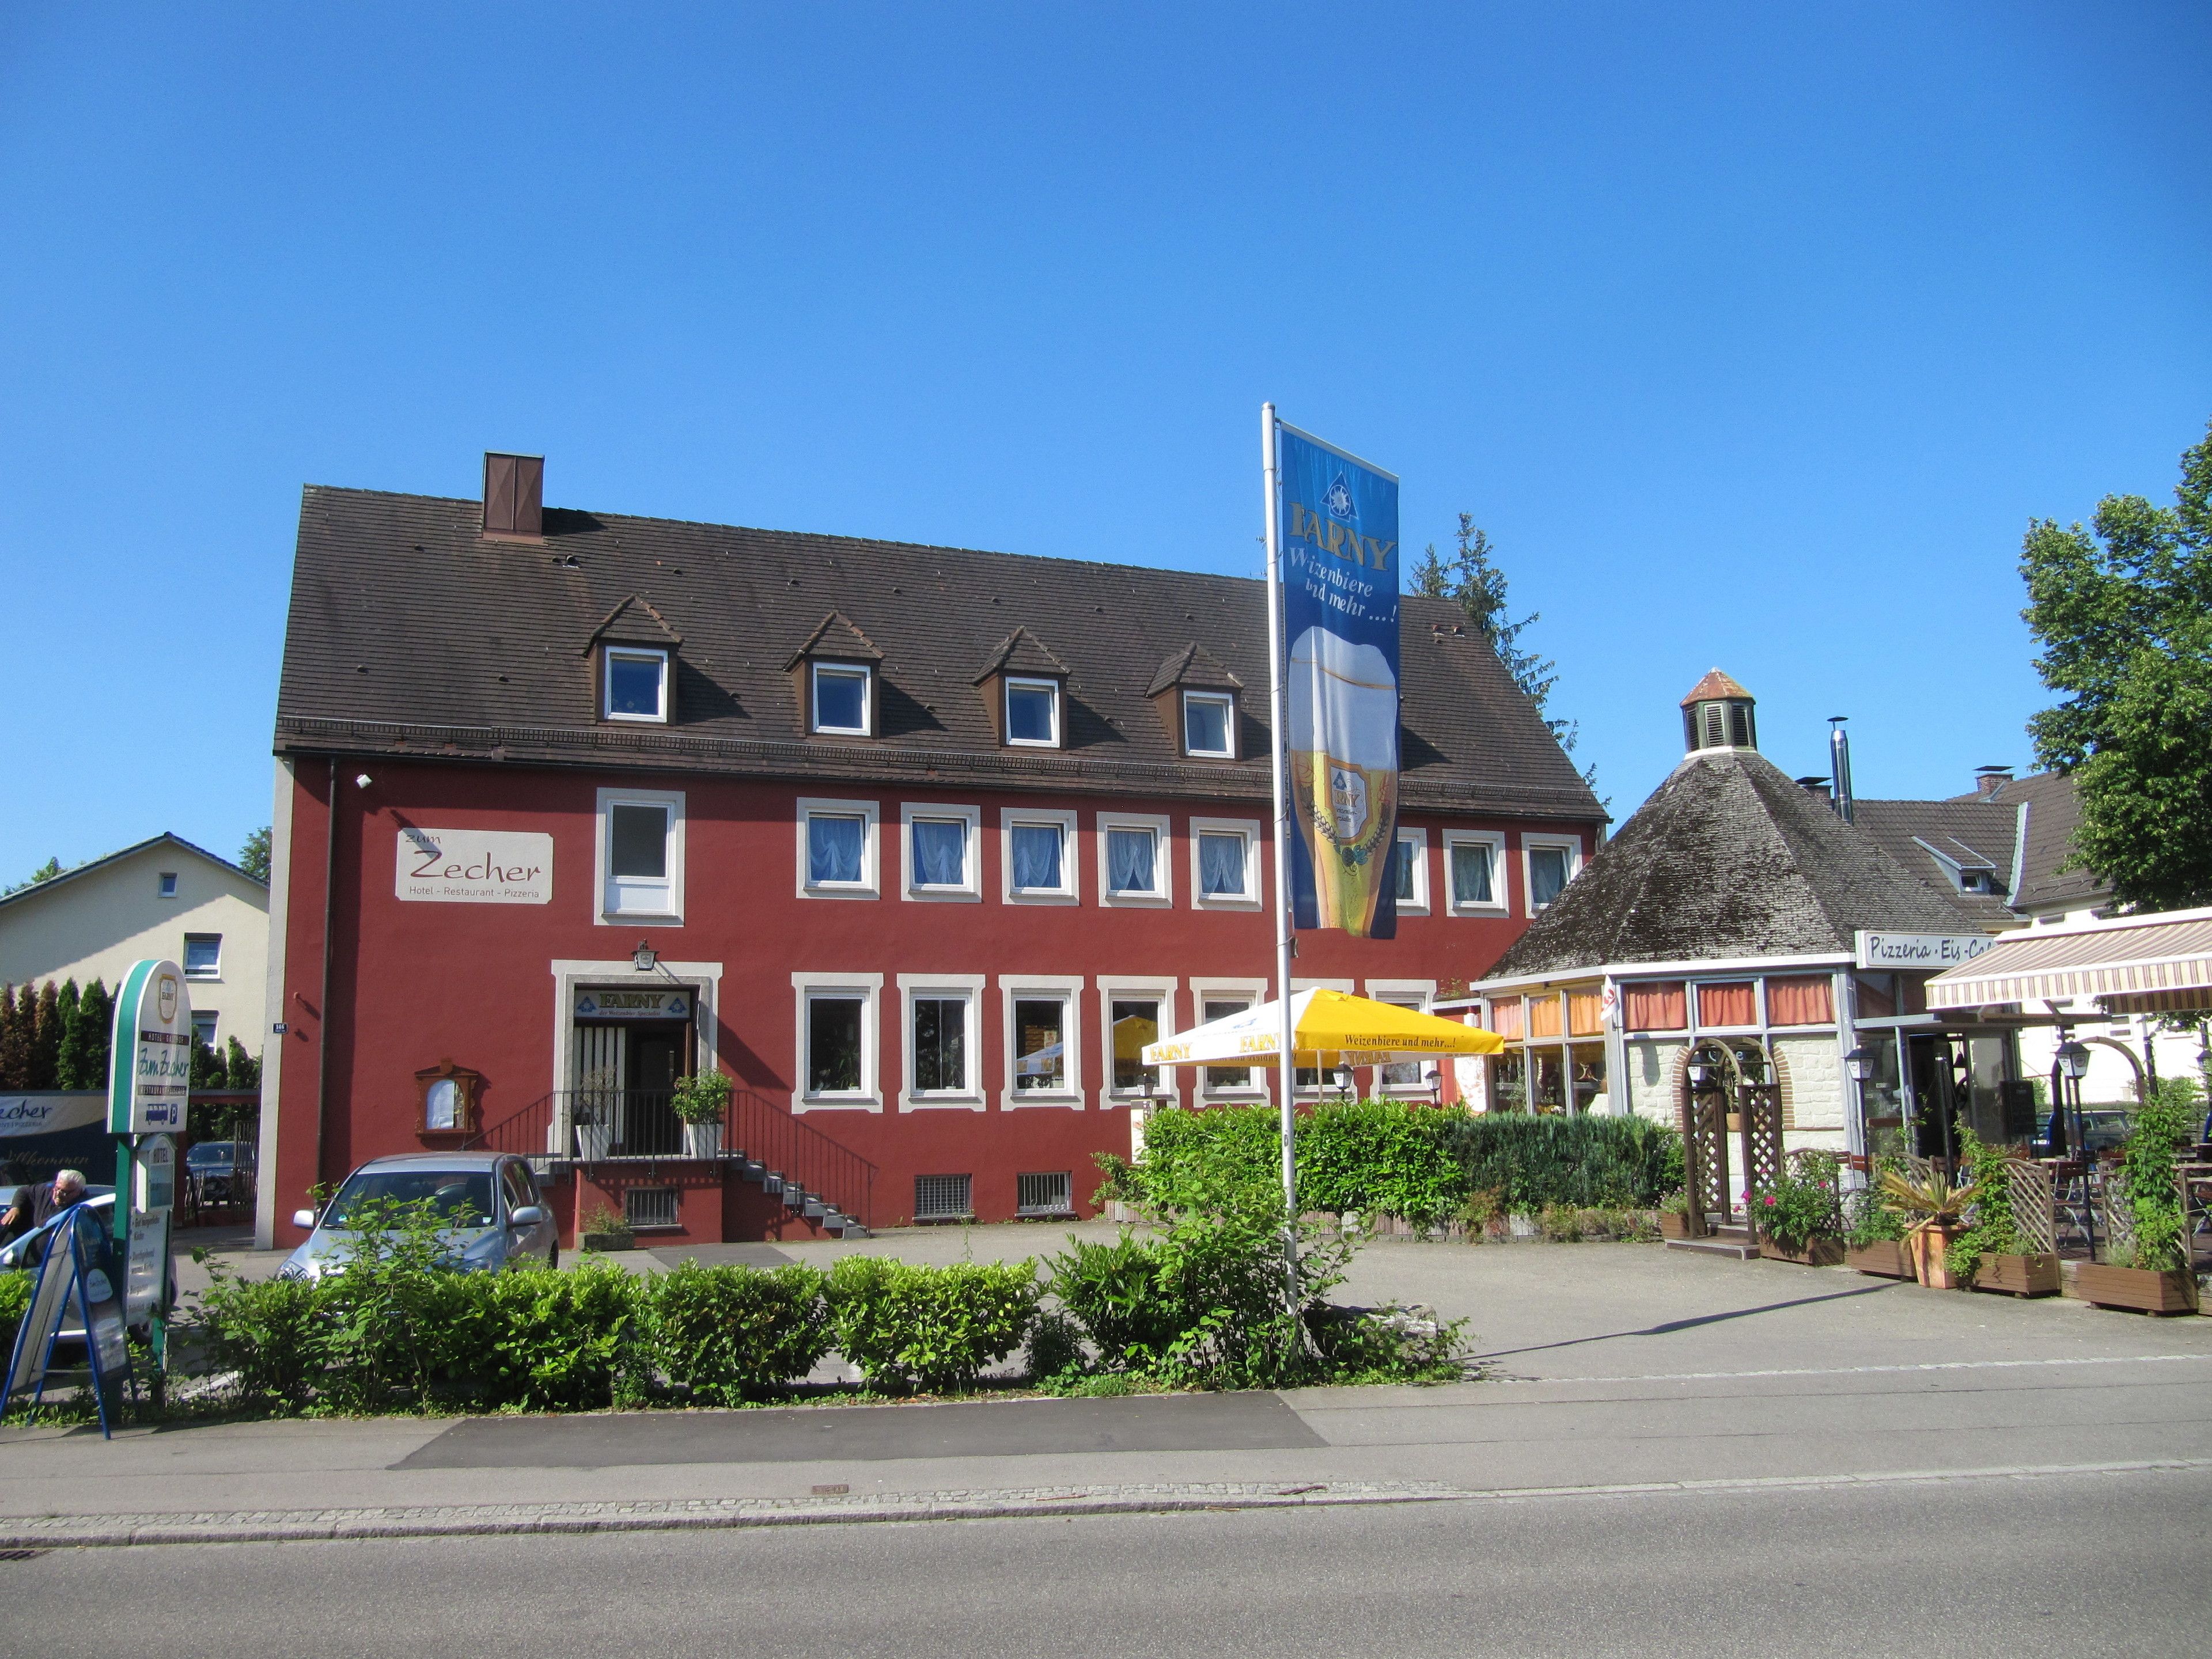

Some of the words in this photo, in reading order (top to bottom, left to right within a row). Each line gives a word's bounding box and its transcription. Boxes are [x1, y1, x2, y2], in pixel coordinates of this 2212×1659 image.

[1290, 547, 1373, 597] Wizenbiere
[1328, 592, 1366, 617] mehr
[410, 850, 541, 882] Zecher
[409, 886, 433, 895] Hotel
[444, 887, 494, 897] Restaurant
[504, 889, 540, 899] Pizzeria
[1869, 935, 1930, 960] Pizzeria
[599, 993, 665, 1009] FARNY
[1344, 1034, 1400, 1047] Weizenbiere
[1402, 1036, 1419, 1047] und
[1149, 1042, 1193, 1062] FARNY
